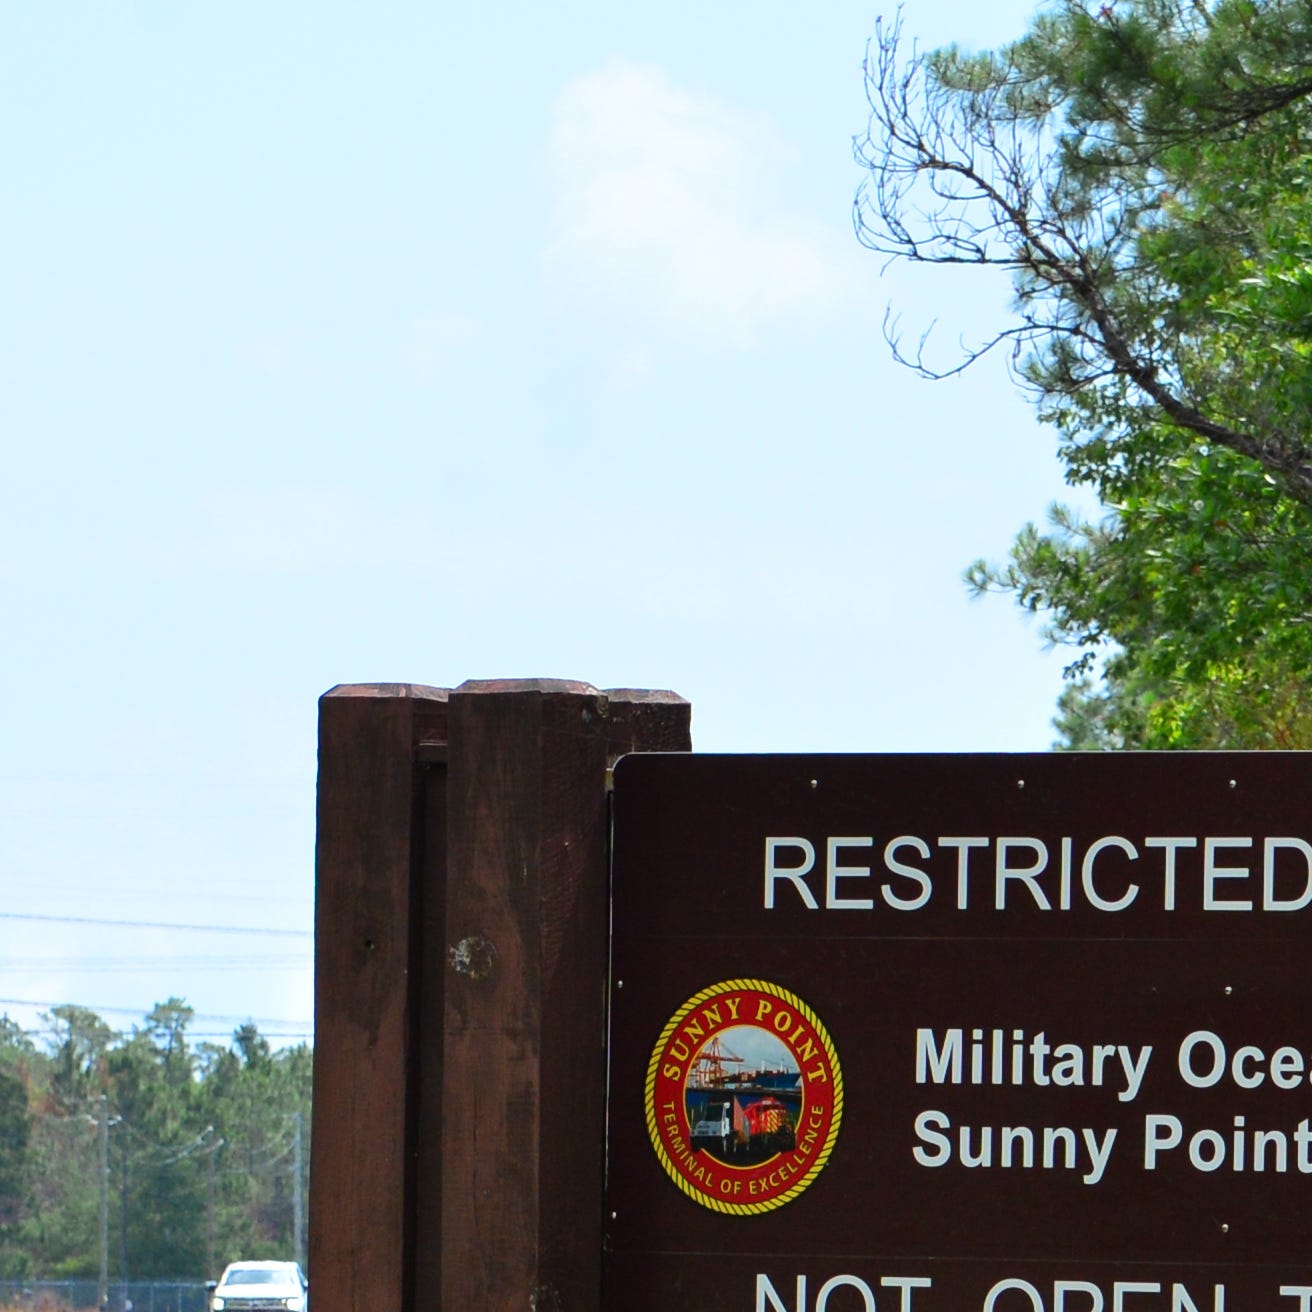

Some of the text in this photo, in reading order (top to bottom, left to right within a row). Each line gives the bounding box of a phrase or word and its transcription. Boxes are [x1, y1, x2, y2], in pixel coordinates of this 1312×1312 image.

[663, 997, 828, 1085] SUNNY POINT
[915, 1028, 1153, 1102] Military
[662, 1100, 824, 1195] TERMINAL OF EXCELLENCE
[912, 1110, 1118, 1185] Sunny
